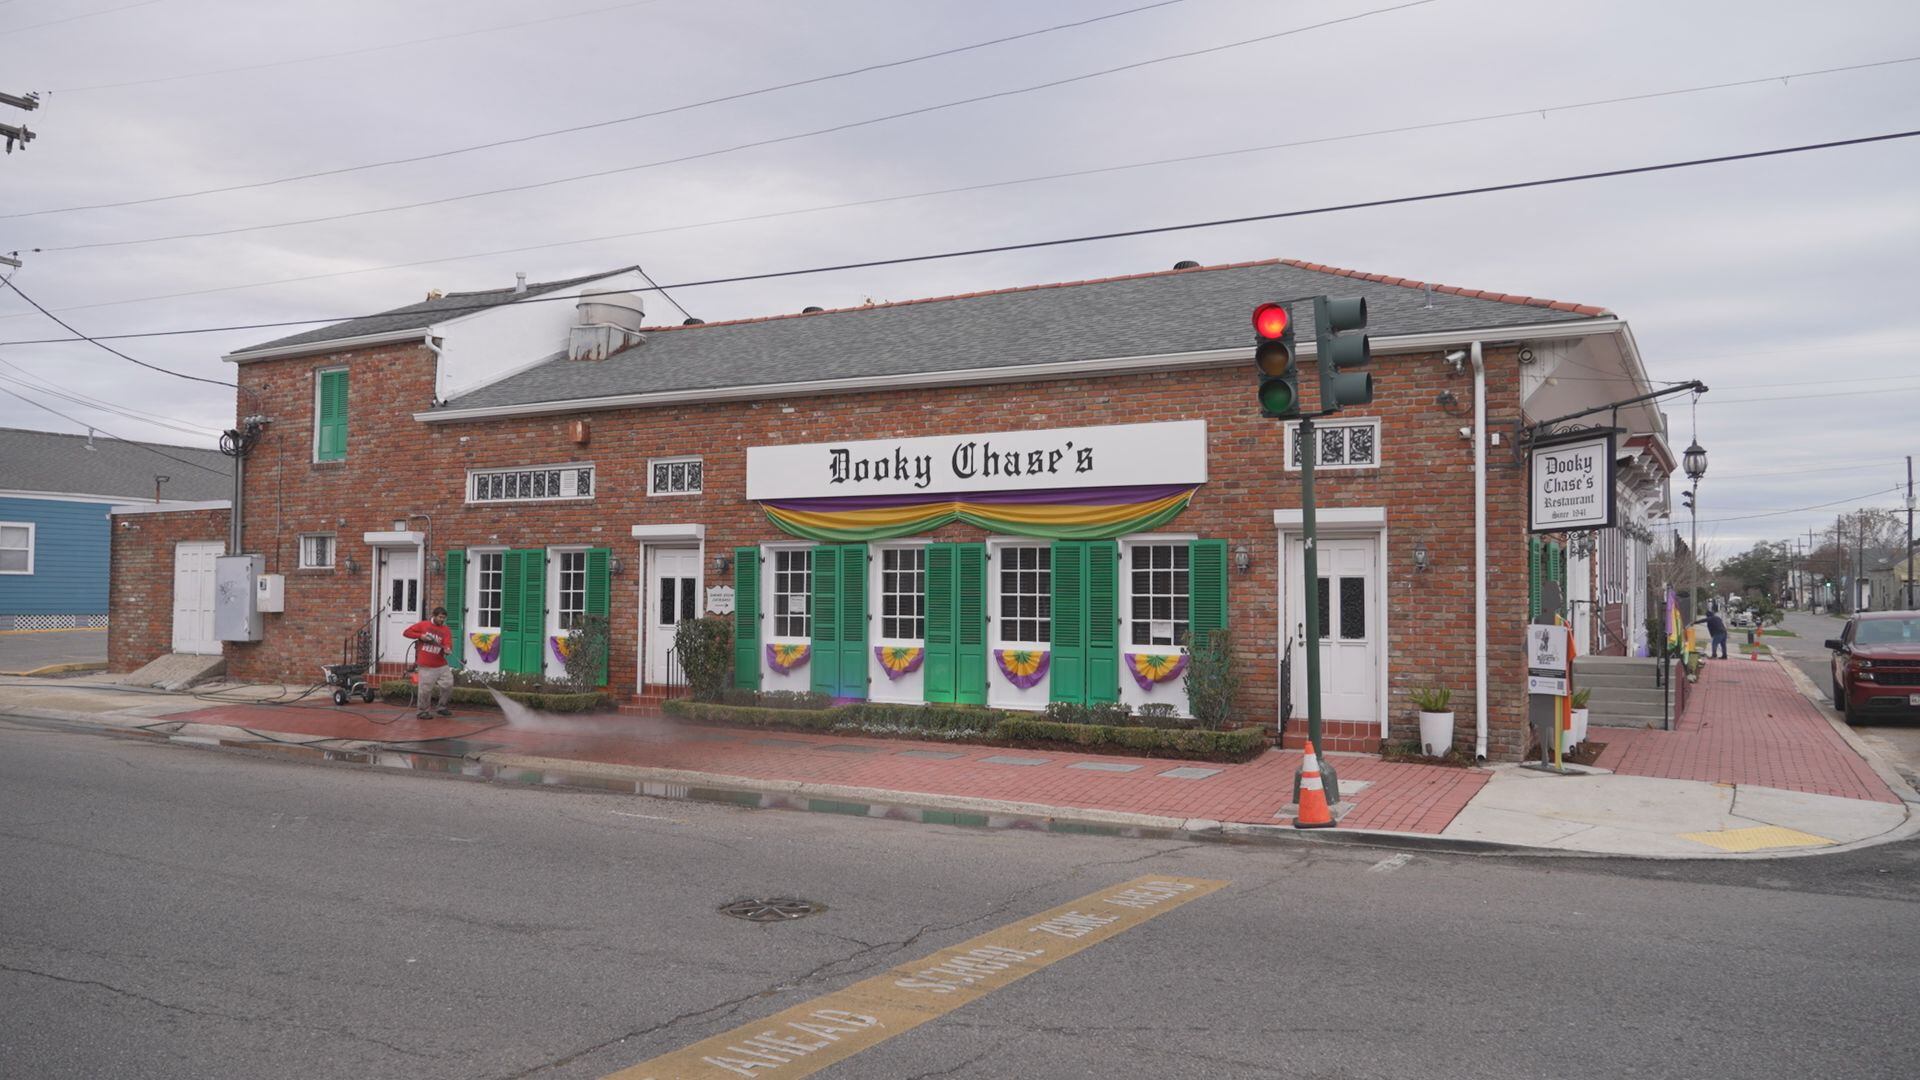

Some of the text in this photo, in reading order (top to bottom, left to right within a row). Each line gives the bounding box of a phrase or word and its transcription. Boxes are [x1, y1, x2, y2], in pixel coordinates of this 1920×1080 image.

[829, 441, 1094, 489] Dooky Chase's
[1545, 453, 1592, 475] Dooky
[1543, 474, 1594, 494] Chase's
[1544, 494, 1595, 509] Restaurant
[894, 881, 1195, 993] SCHOOL ZONE AHEAD
[702, 1009, 878, 1078] AHEAD
